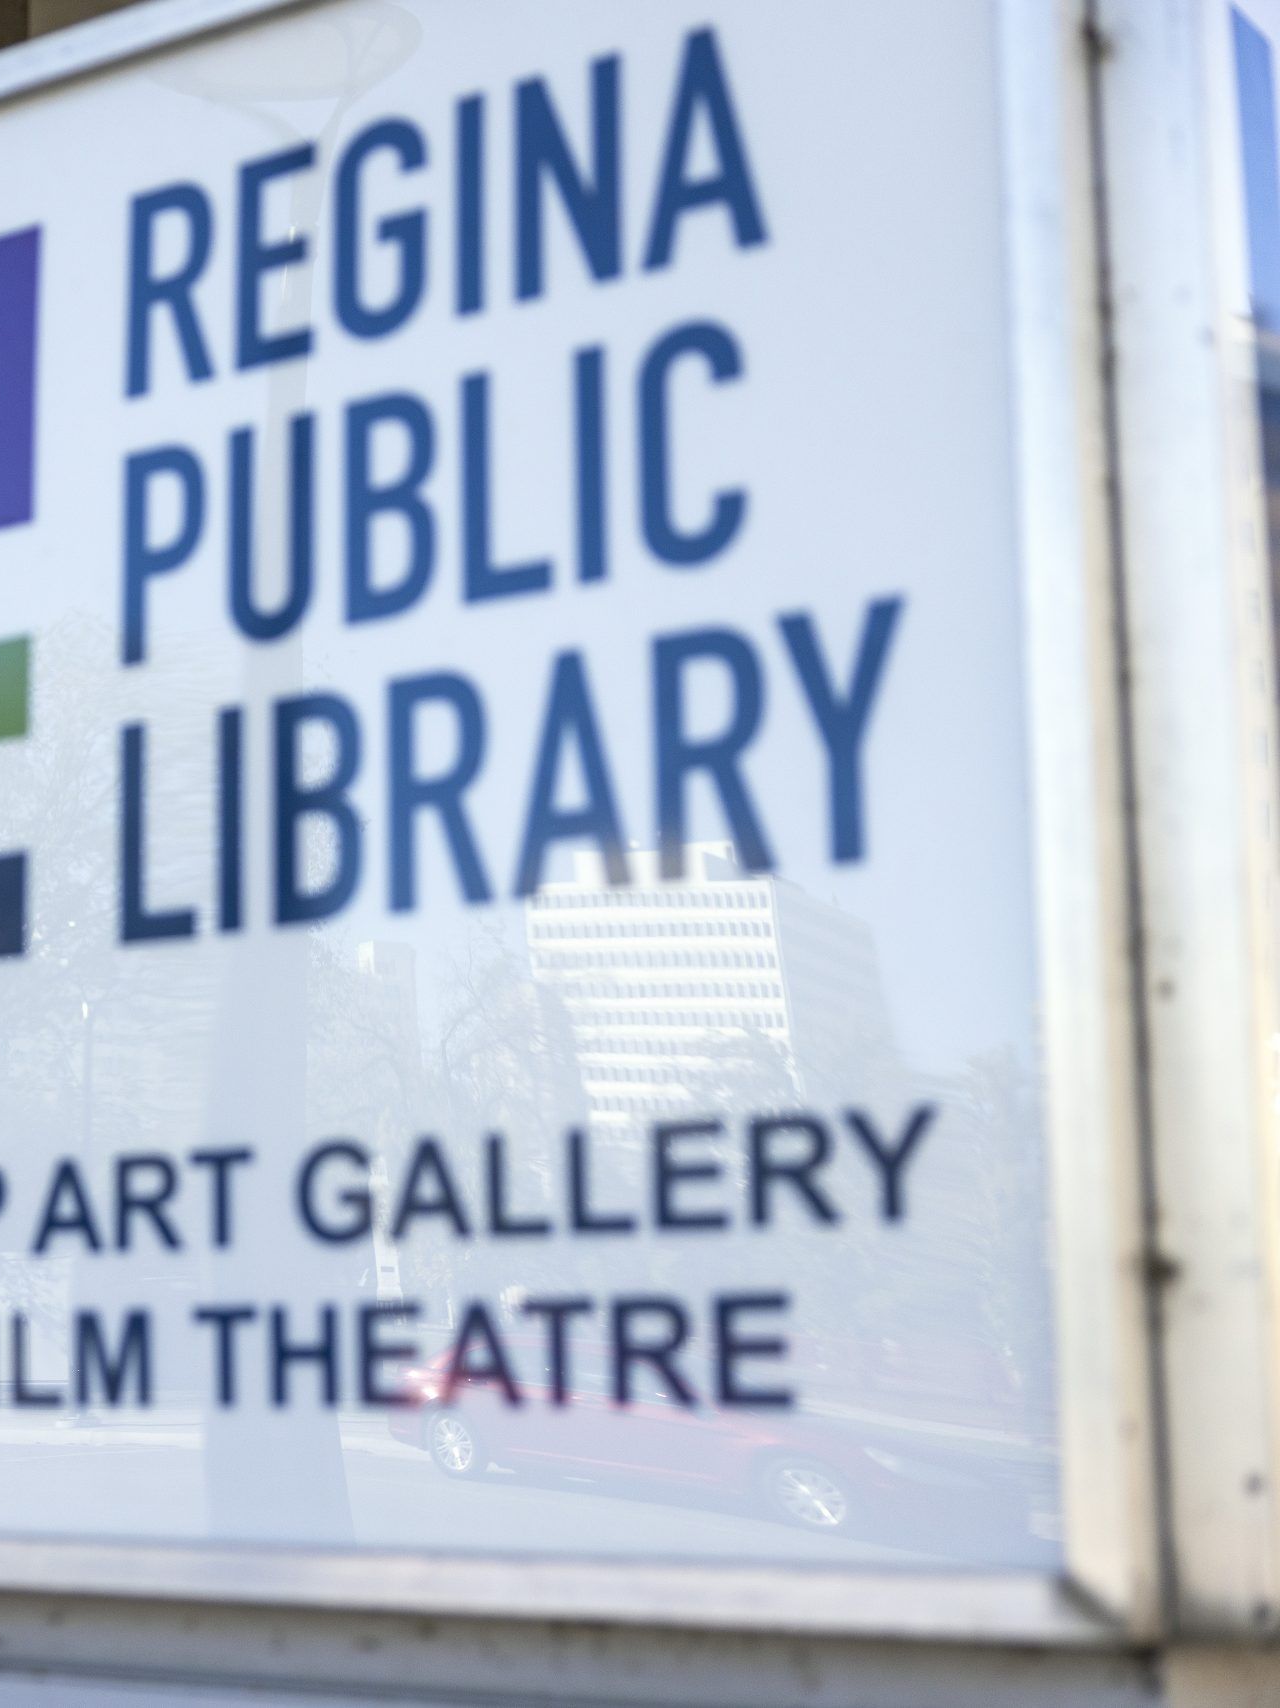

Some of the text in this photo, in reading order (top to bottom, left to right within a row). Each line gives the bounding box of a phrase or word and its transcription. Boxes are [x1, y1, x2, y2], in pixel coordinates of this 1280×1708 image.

[124, 25, 770, 402] REGINA
[120, 318, 748, 669] PUBLIC
[117, 593, 906, 946] LIBRARY
[30, 1145, 256, 1257] ART
[293, 1104, 936, 1249] GALLERY
[191, 1290, 797, 1413] THEATRE
